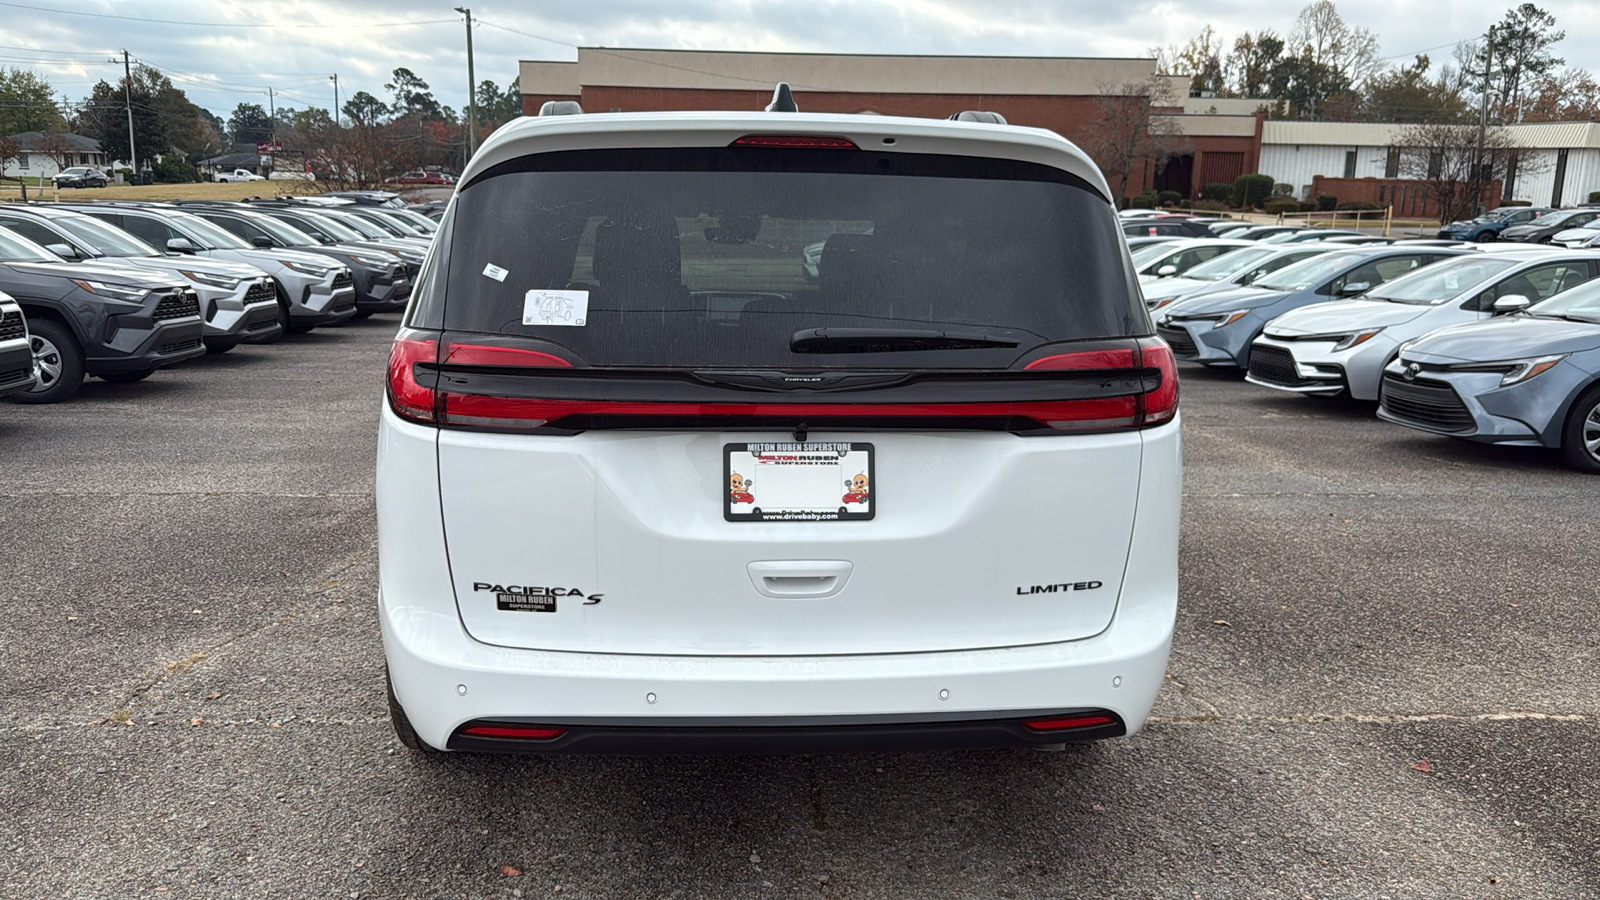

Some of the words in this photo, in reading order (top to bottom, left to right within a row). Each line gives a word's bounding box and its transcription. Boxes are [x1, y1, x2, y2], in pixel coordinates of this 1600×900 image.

[747, 443, 775, 452] MILTON
[776, 443, 801, 452] RUBEN
[803, 443, 852, 452] SUPERSTORE
[762, 513, 838, 521] www.drivebaby.com
[1016, 580, 1103, 596] LIMITED
[473, 582, 585, 598] PACIFICA
[582, 593, 605, 606] S
[499, 594, 527, 604] MILTON
[528, 595, 554, 605] RUBEN
